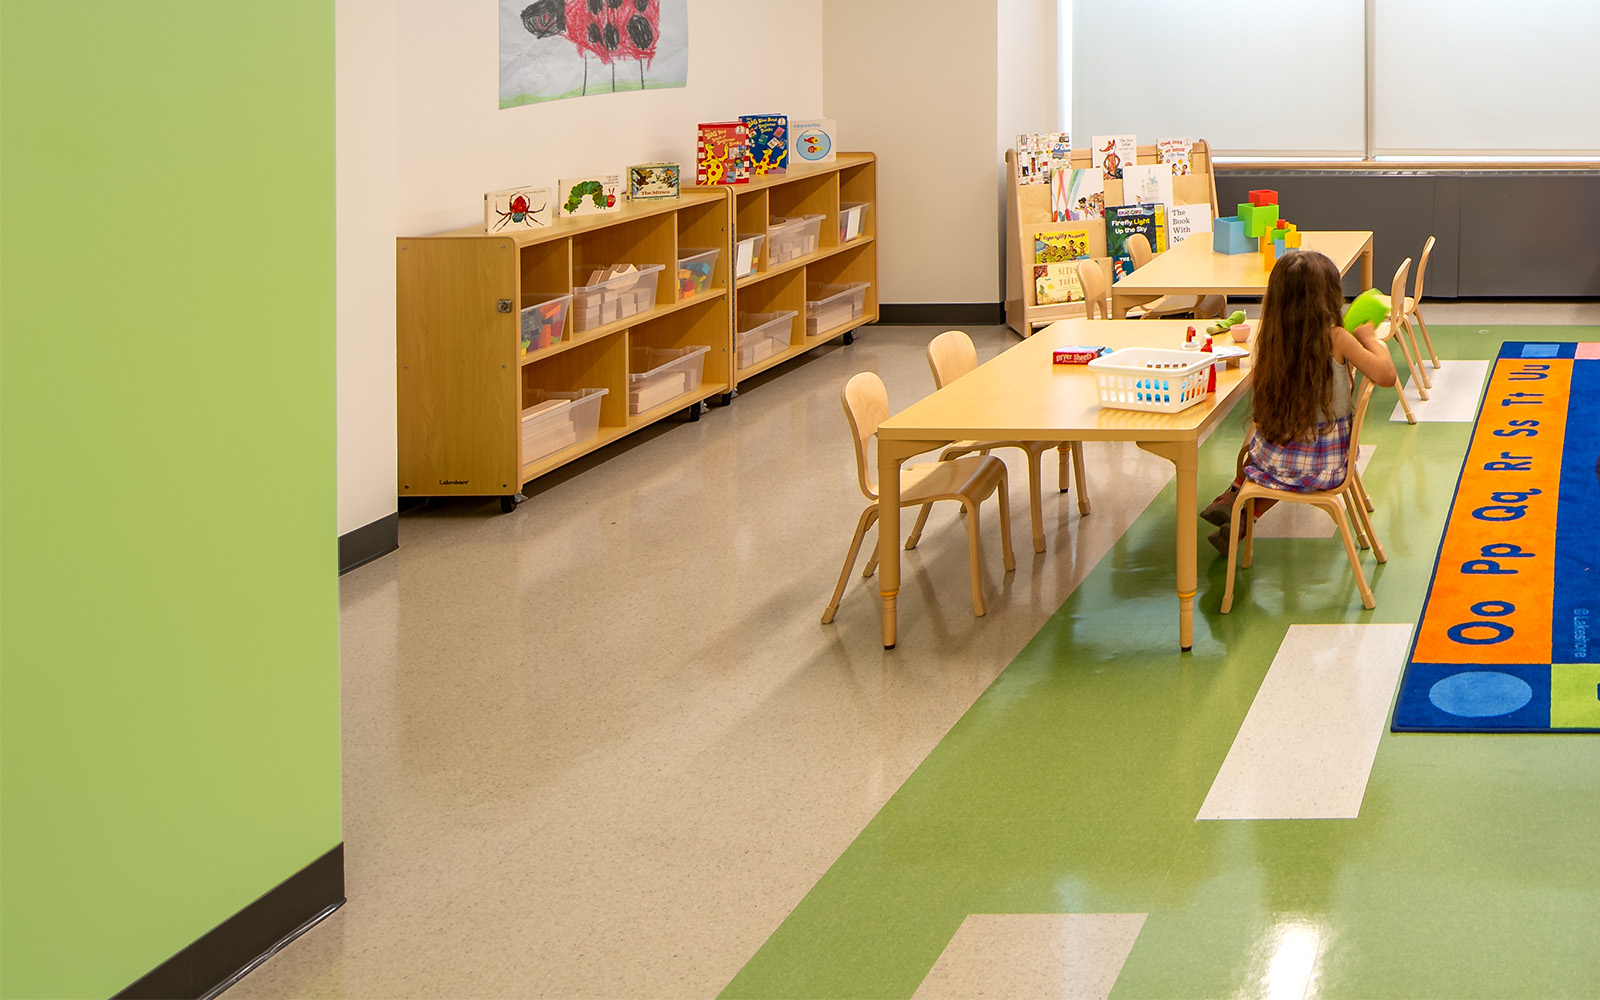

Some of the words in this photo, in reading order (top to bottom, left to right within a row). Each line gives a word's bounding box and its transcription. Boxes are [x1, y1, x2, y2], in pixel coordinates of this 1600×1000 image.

[1172, 209, 1186, 217] The
[1133, 218, 1151, 226] Light
[1172, 217, 1191, 225] Book
[1136, 226, 1148, 234] Sky
[1173, 226, 1191, 234] With
[1173, 235, 1185, 243] No
[1059, 277, 1079, 287] TREES
[1507, 364, 1551, 381] Uu
[1501, 392, 1545, 407] Tt
[1492, 419, 1540, 437] Ss
[1483, 451, 1534, 471] Rr
[1471, 488, 1543, 522] Qq
[1460, 543, 1536, 575] Pp
[1446, 600, 1516, 646] Oo
